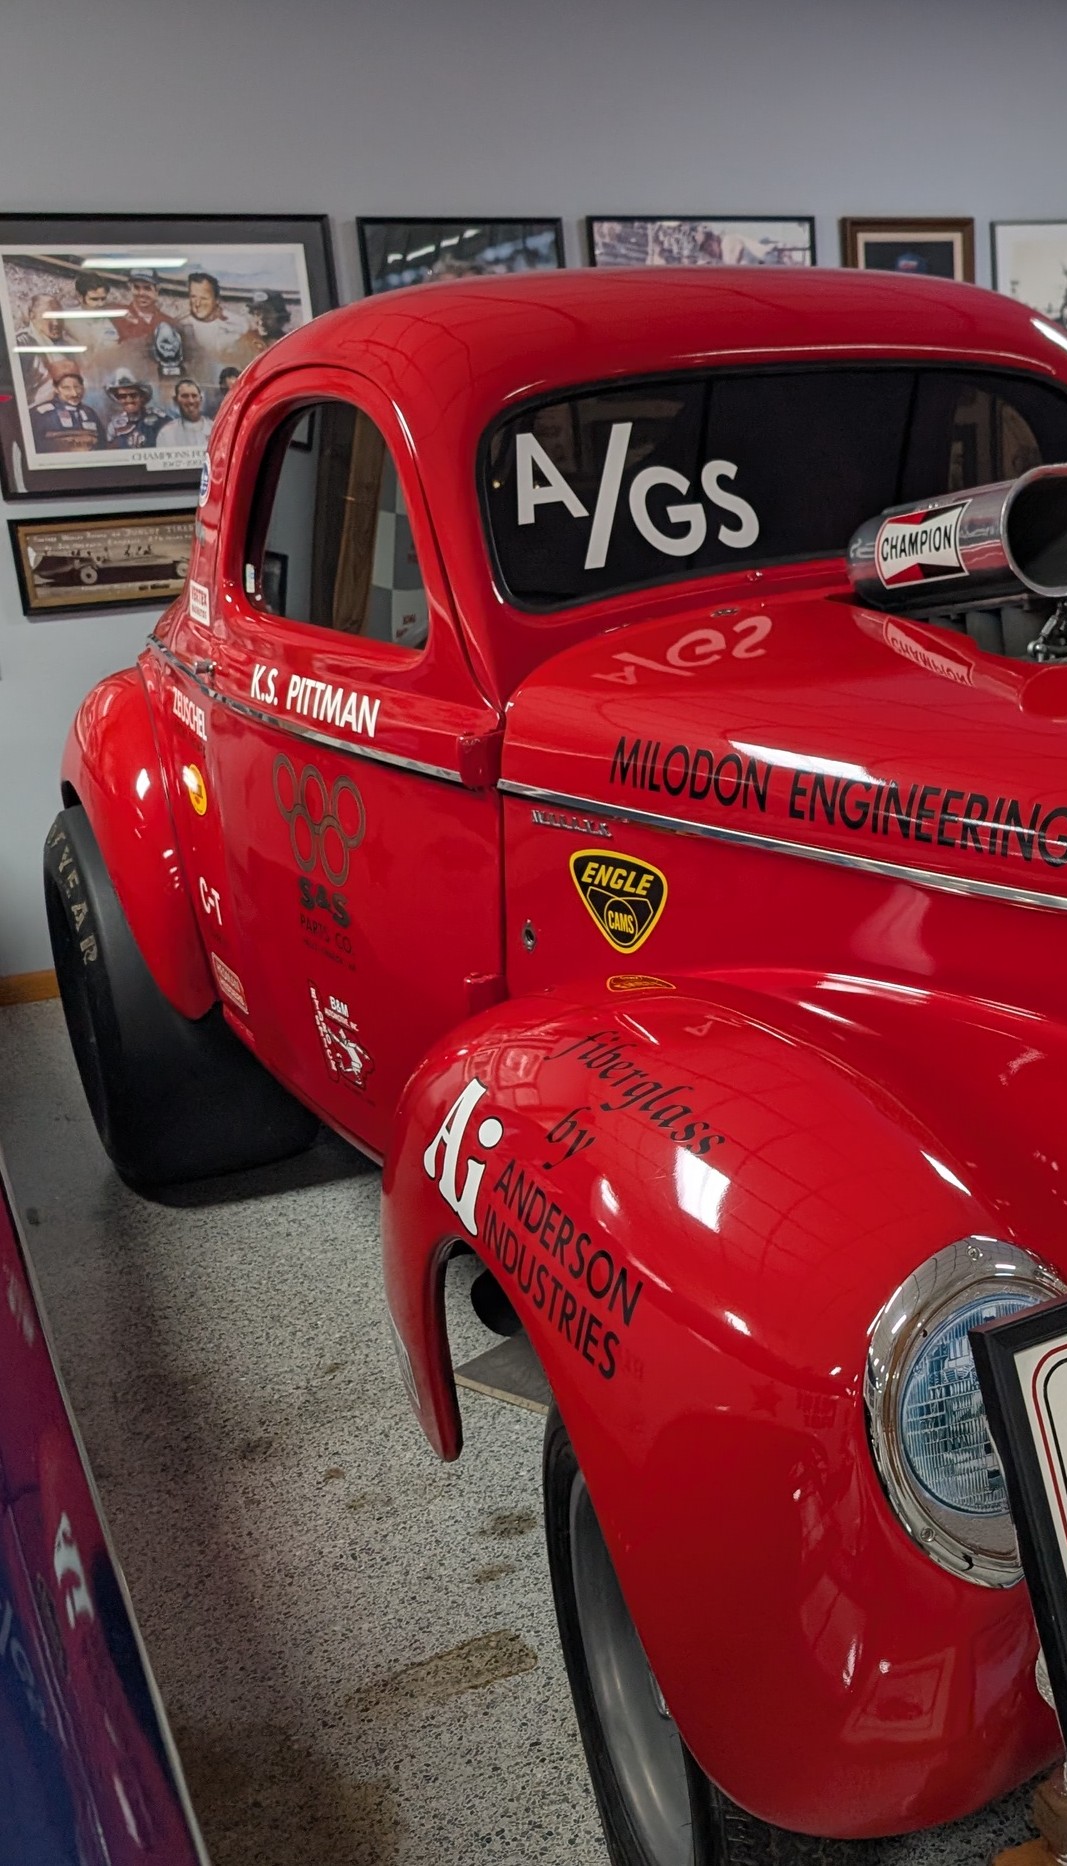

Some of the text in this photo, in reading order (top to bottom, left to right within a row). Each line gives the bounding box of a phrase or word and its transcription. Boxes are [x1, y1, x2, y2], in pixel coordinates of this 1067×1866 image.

[515, 421, 760, 571] A/GS
[880, 521, 953, 563] CHAMPION
[250, 663, 381, 738] K.S. PITTMAN
[609, 735, 773, 813] MILODON
[298, 876, 351, 929] S&S
[580, 859, 655, 897] ENGLE
[608, 910, 635, 936] CAMS
[329, 995, 349, 1018] B&M
[544, 1031, 725, 1156] fiberglass
[544, 1106, 597, 1170] by
[494, 1159, 644, 1327] ANDERSON
[482, 1204, 622, 1380] INDUSTRIES
